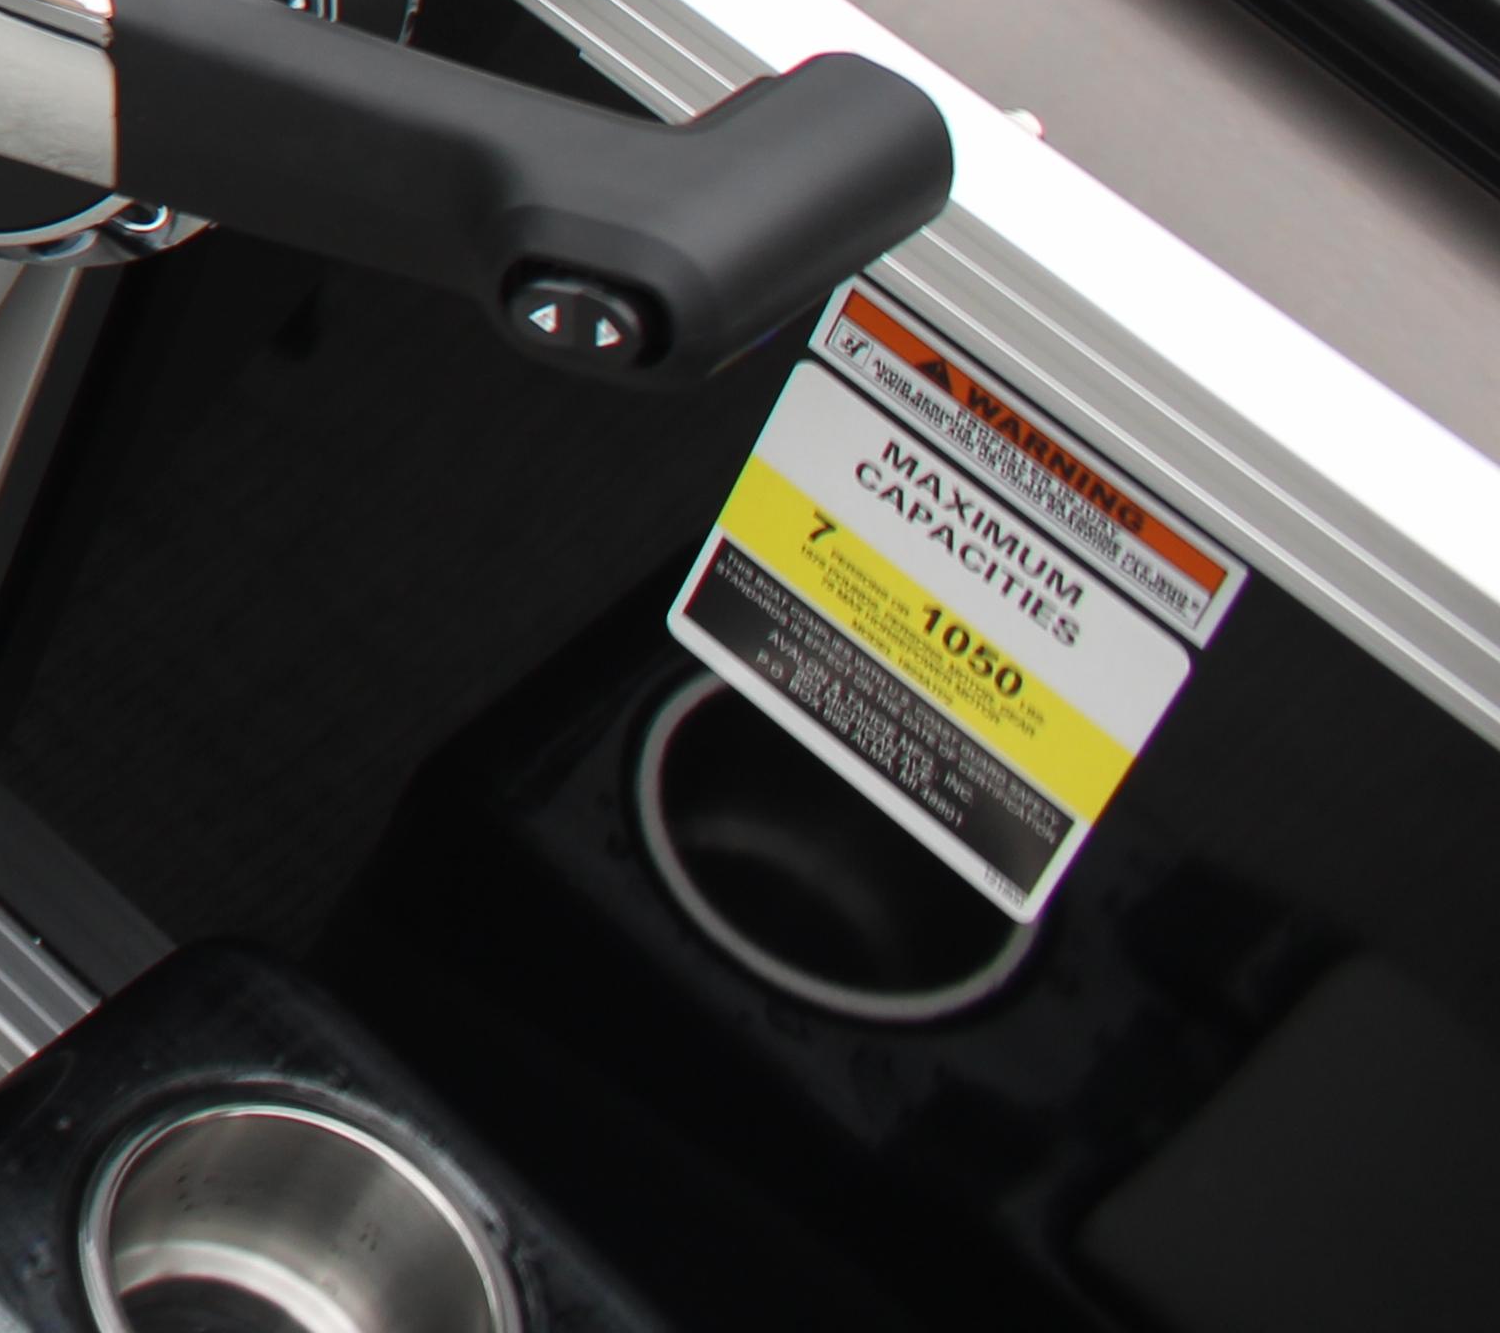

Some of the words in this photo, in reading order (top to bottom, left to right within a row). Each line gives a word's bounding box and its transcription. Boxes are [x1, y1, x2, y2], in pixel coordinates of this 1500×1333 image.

[877, 438, 1087, 611] MAXIMUM
[961, 384, 1150, 537] WARNING
[801, 508, 838, 552] 7
[912, 598, 1028, 704] 1050
[849, 456, 1085, 651] CAPACITIES
[713, 559, 790, 627] STANDARDS
[787, 618, 805, 639] IN
[802, 630, 854, 678] EFFECT
[851, 670, 876, 697] ON
[873, 688, 903, 718] THE
[899, 709, 938, 747] DATE
[935, 738, 958, 764] OF
[955, 755, 1059, 845] CERTIFICATION
[724, 550, 755, 581] THIS
[751, 571, 790, 609] BOAT
[786, 600, 855, 663] COMPLIES
[849, 651, 890, 690] WITH
[910, 700, 960, 747] COAST
[956, 737, 1010, 787] GUARD
[1006, 777, 1064, 830] SAFETY
[765, 625, 832, 686] AVALON
[841, 687, 899, 741] TAHOE
[786, 675, 824, 713] BOX
[896, 765, 920, 792] MI
[820, 688, 900, 759] MICHIGAN
